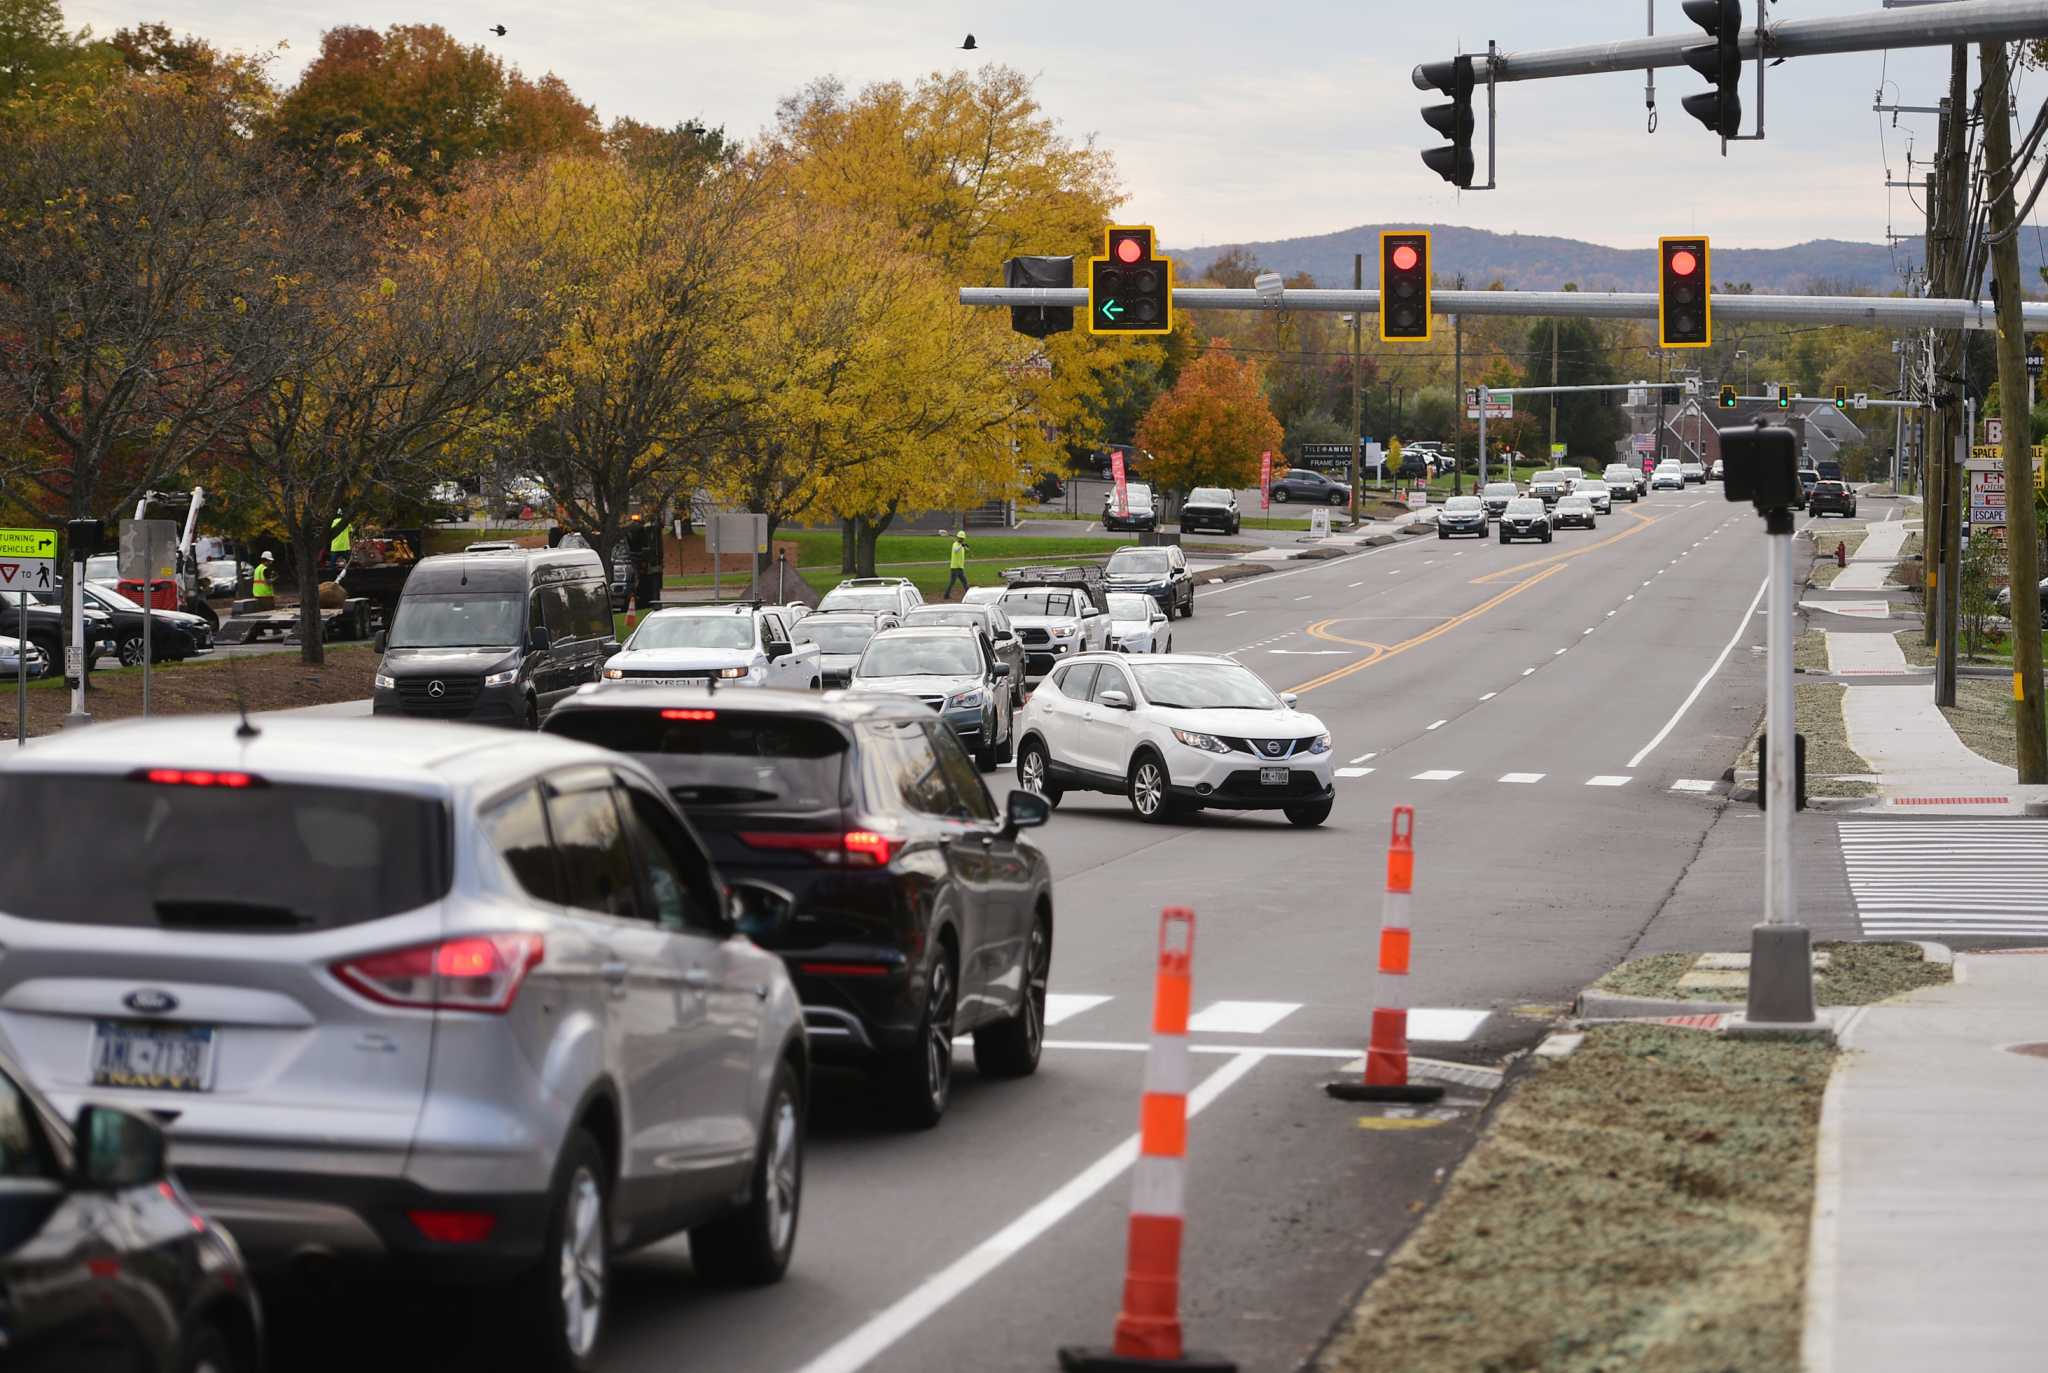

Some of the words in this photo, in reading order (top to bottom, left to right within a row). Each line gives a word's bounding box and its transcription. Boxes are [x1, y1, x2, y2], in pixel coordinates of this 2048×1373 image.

[1972, 448, 1998, 458] SPACE
[1975, 510, 2003, 520] ESCAPE
[22, 571, 32, 579] TO
